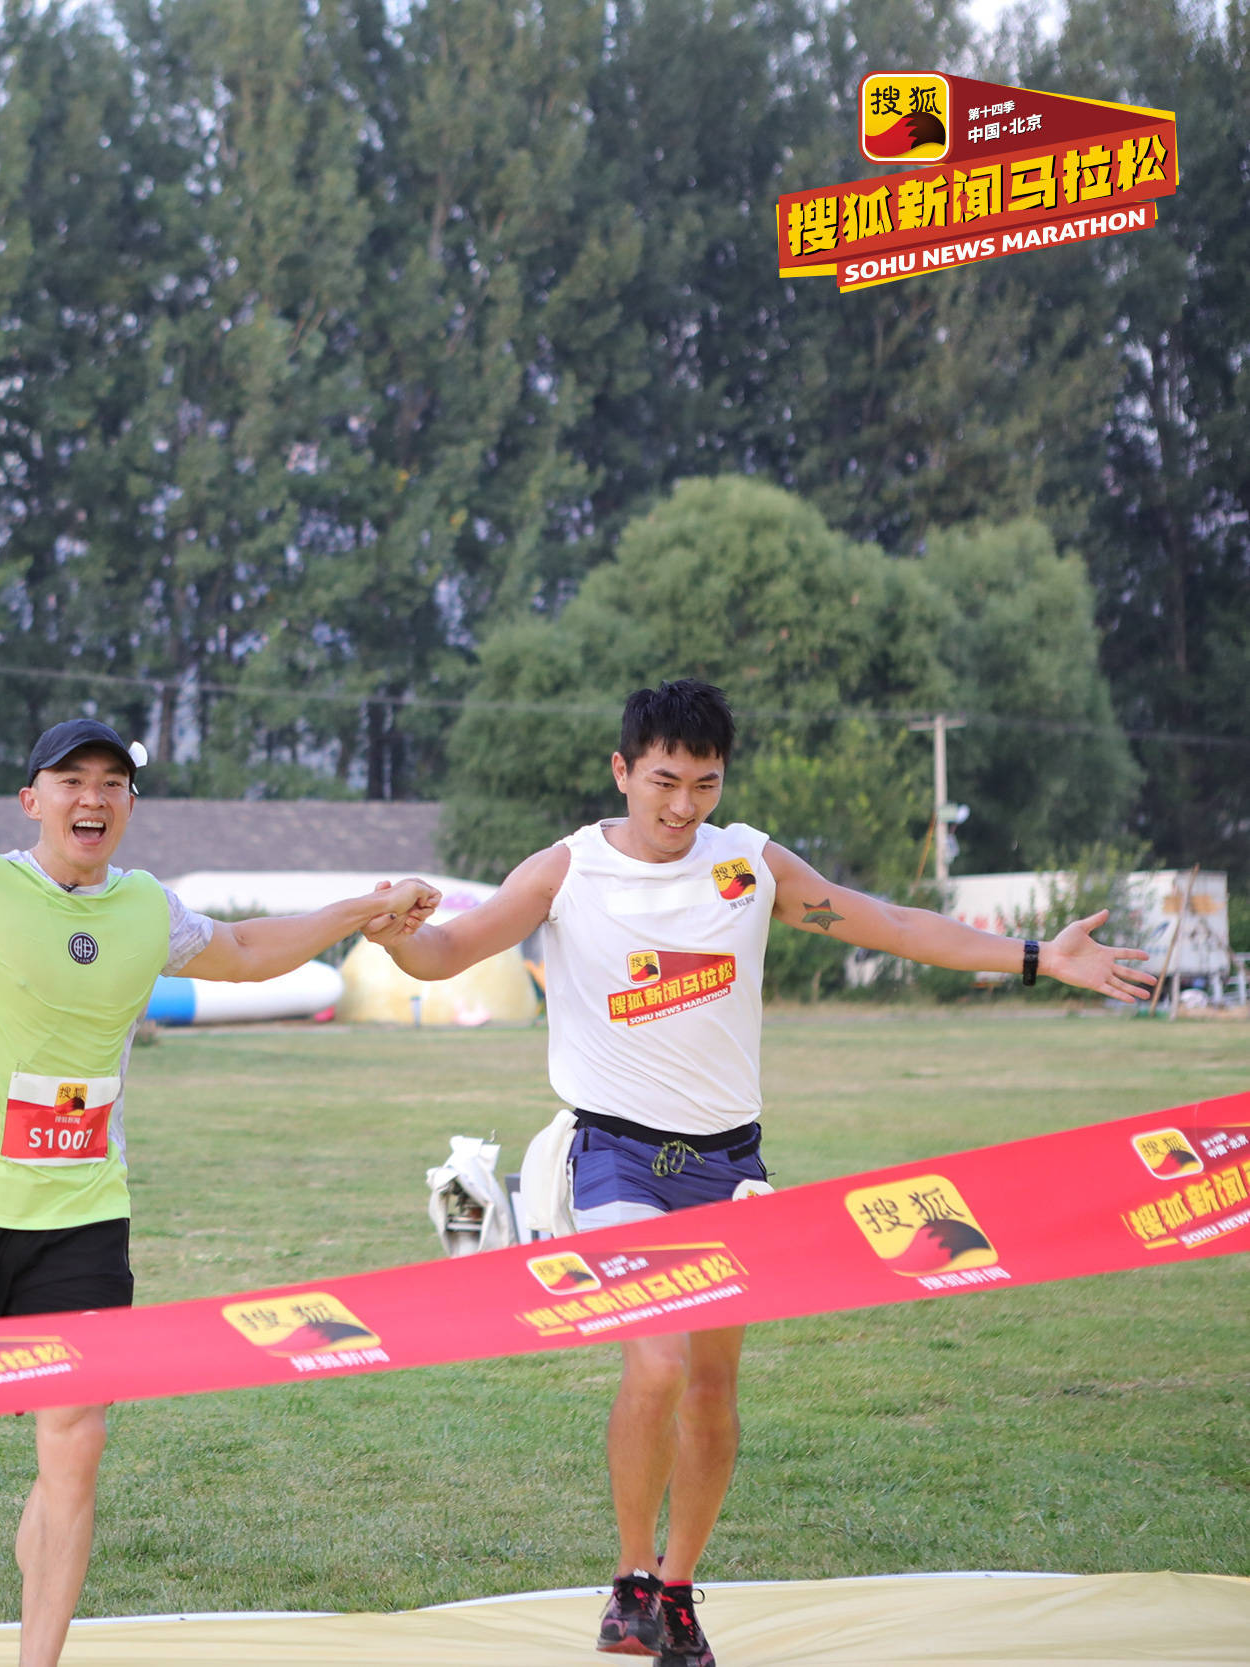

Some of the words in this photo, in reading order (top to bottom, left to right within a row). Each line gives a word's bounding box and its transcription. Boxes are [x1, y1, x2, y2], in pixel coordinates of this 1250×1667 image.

[714, 862, 751, 881] 搜狐
[610, 962, 734, 1016] 搜狐新闻马拉松
[629, 1013, 654, 1025] SOHU
[655, 1006, 681, 1019] NEWS
[682, 987, 729, 1010] MARATHON
[859, 1187, 966, 1234] 搜狐
[1217, 1210, 1250, 1232] NEW
[662, 1284, 743, 1313] MARATHON
